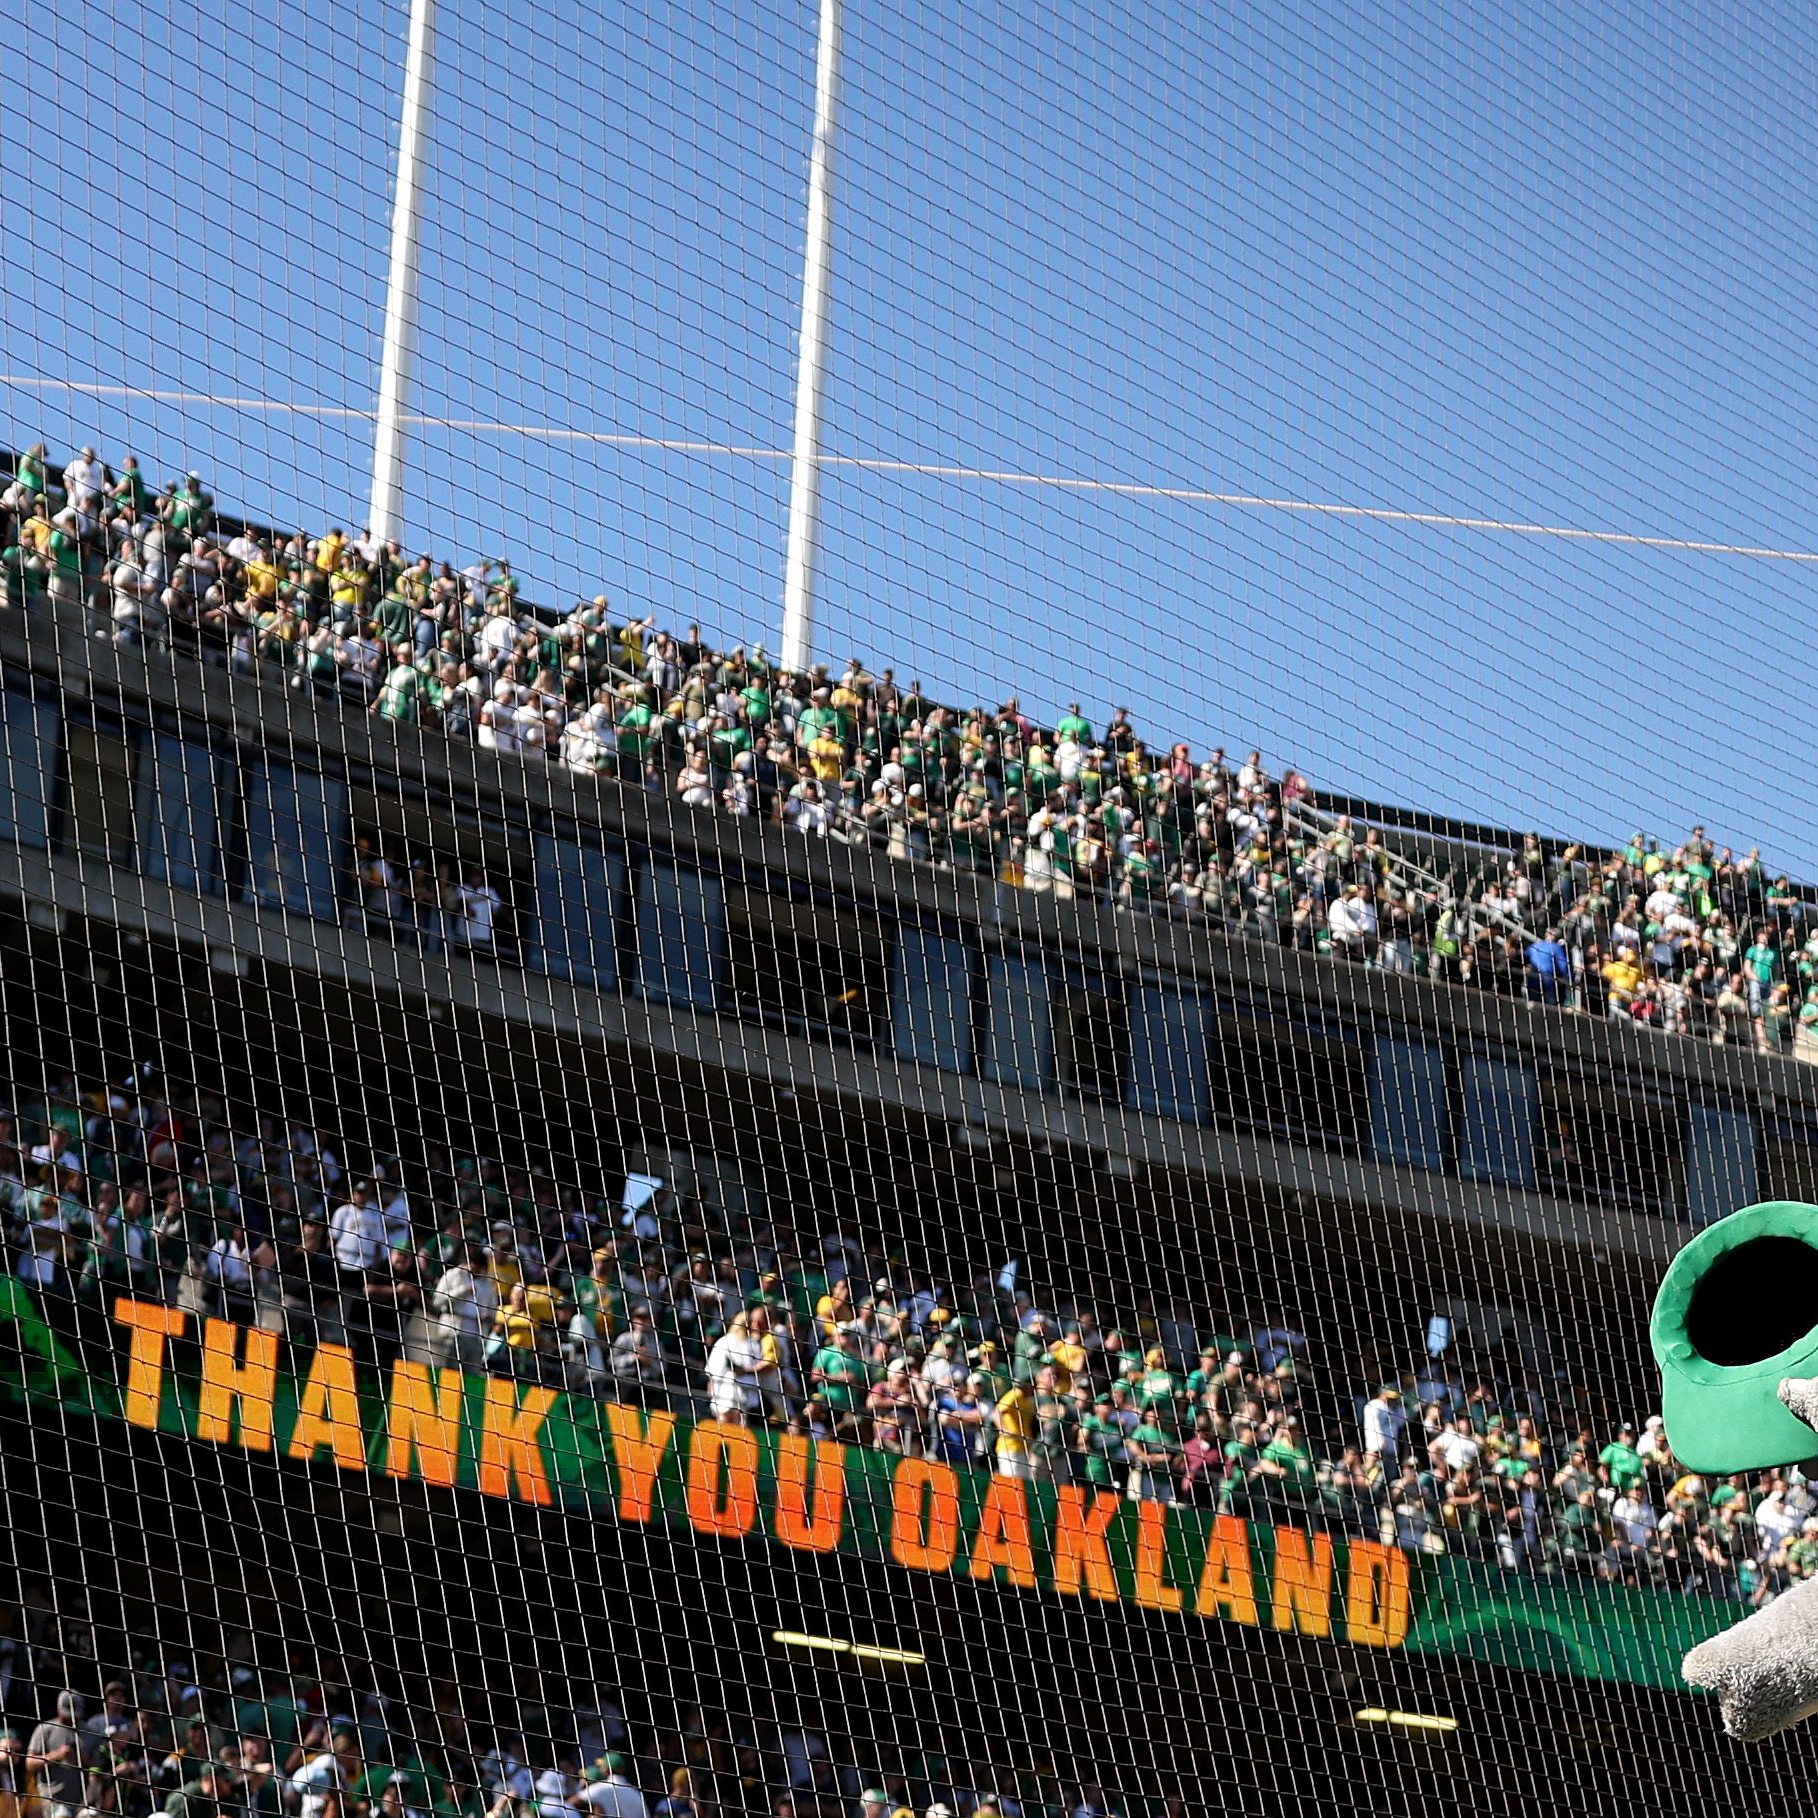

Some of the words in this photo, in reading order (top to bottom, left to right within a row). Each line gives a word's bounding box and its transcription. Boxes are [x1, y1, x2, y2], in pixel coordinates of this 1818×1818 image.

[113, 1297, 561, 1506] THANK
[605, 1402, 846, 1554] YOU
[890, 1456, 1412, 1649] OAKLAND
